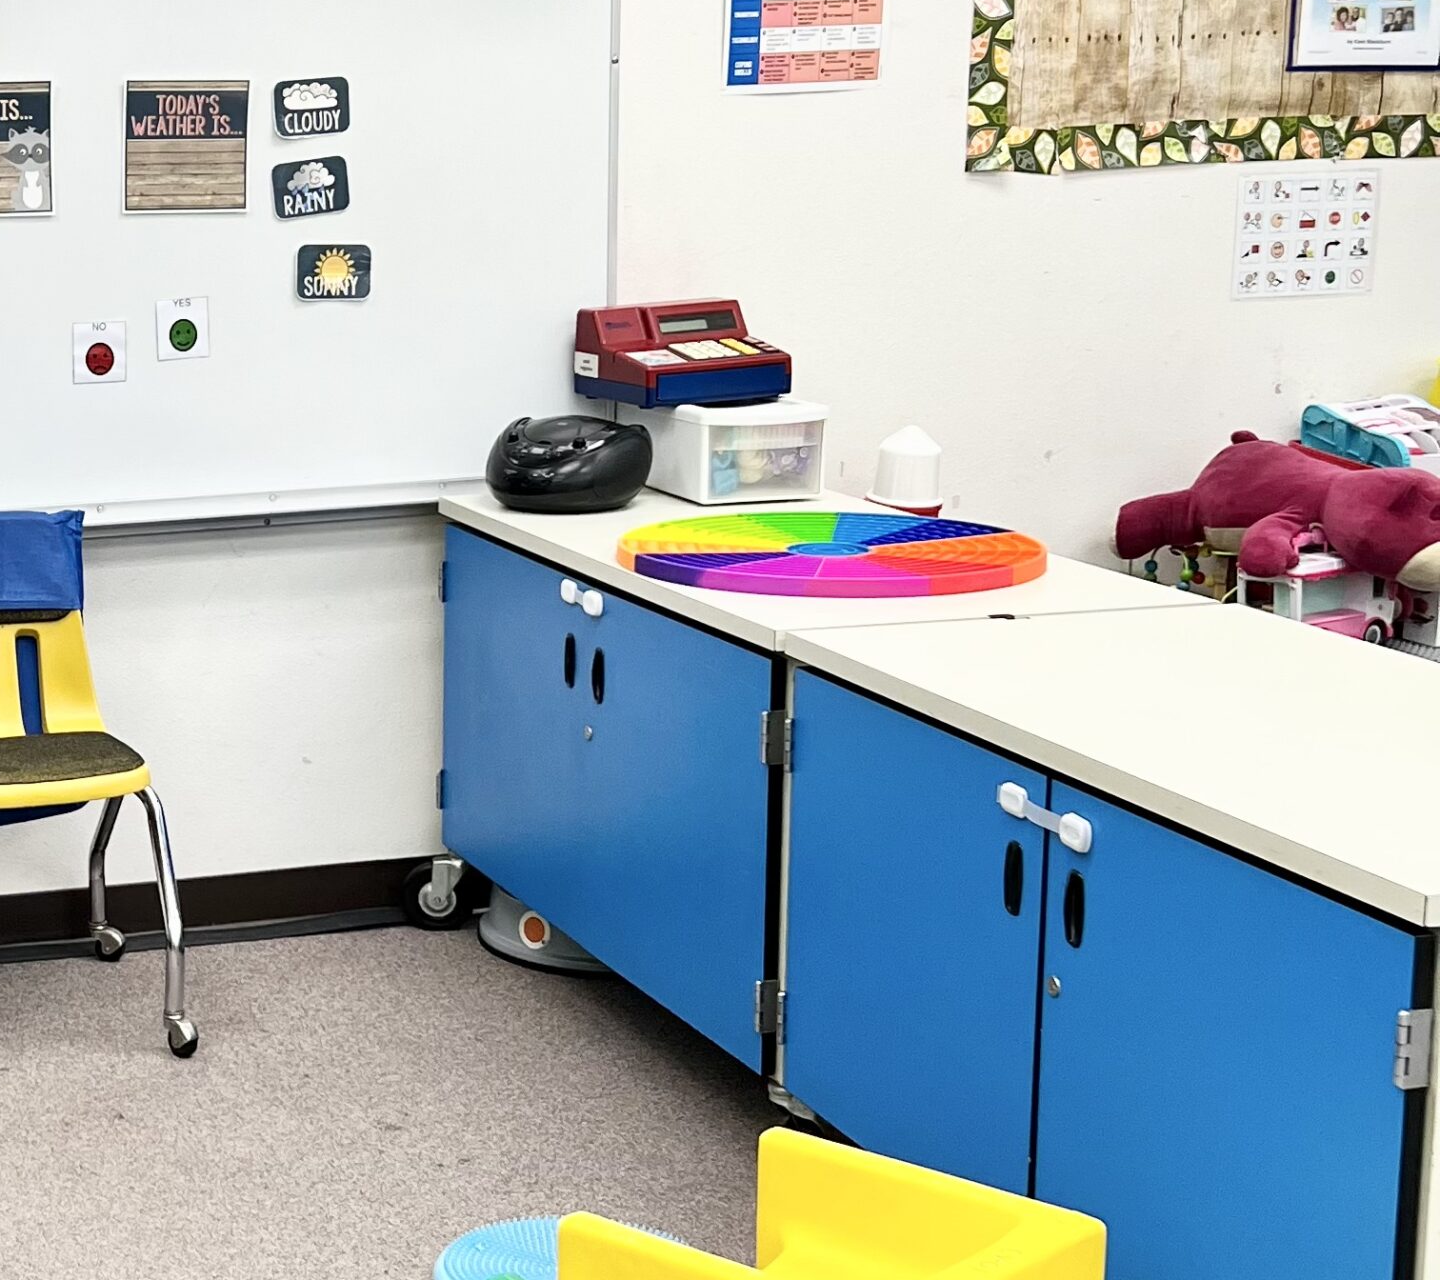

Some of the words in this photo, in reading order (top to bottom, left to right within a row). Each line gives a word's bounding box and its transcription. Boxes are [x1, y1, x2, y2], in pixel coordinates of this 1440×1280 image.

[156, 94, 220, 116] TODAY'S
[130, 115, 207, 138] WEATHER
[210, 114, 244, 136] IS...
[283, 109, 341, 132] CLOUDY
[282, 189, 335, 217] RAINY
[303, 275, 359, 297] SUNNY
[172, 297, 192, 308] YES
[91, 322, 108, 332] NO
